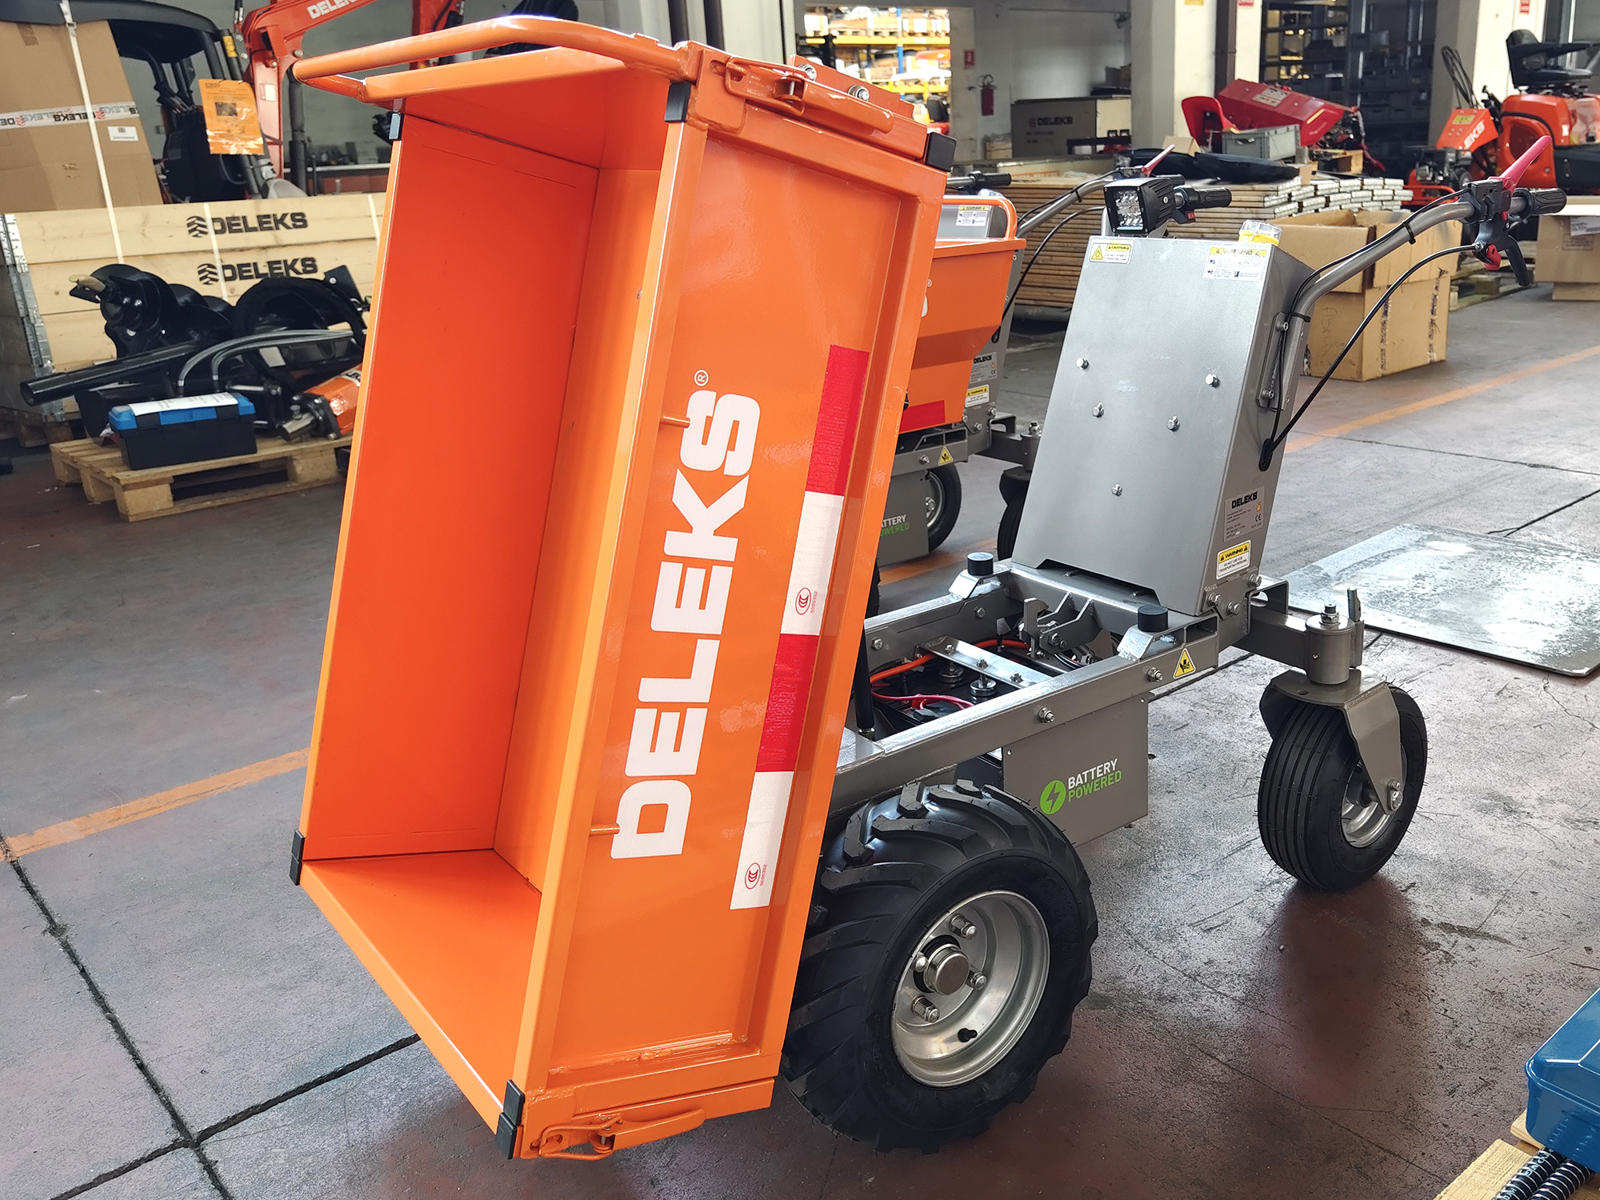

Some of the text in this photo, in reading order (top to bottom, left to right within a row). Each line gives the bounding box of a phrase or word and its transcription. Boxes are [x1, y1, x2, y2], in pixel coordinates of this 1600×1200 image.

[53, 112, 96, 122] ELEKS
[1037, 116, 1073, 126] DELEKS
[211, 211, 309, 236] DELEKS
[221, 256, 319, 282] DELEKS
[1231, 491, 1259, 510] DELEKS
[1068, 758, 1118, 790] BATTERY
[1068, 770, 1122, 803] POWERED
